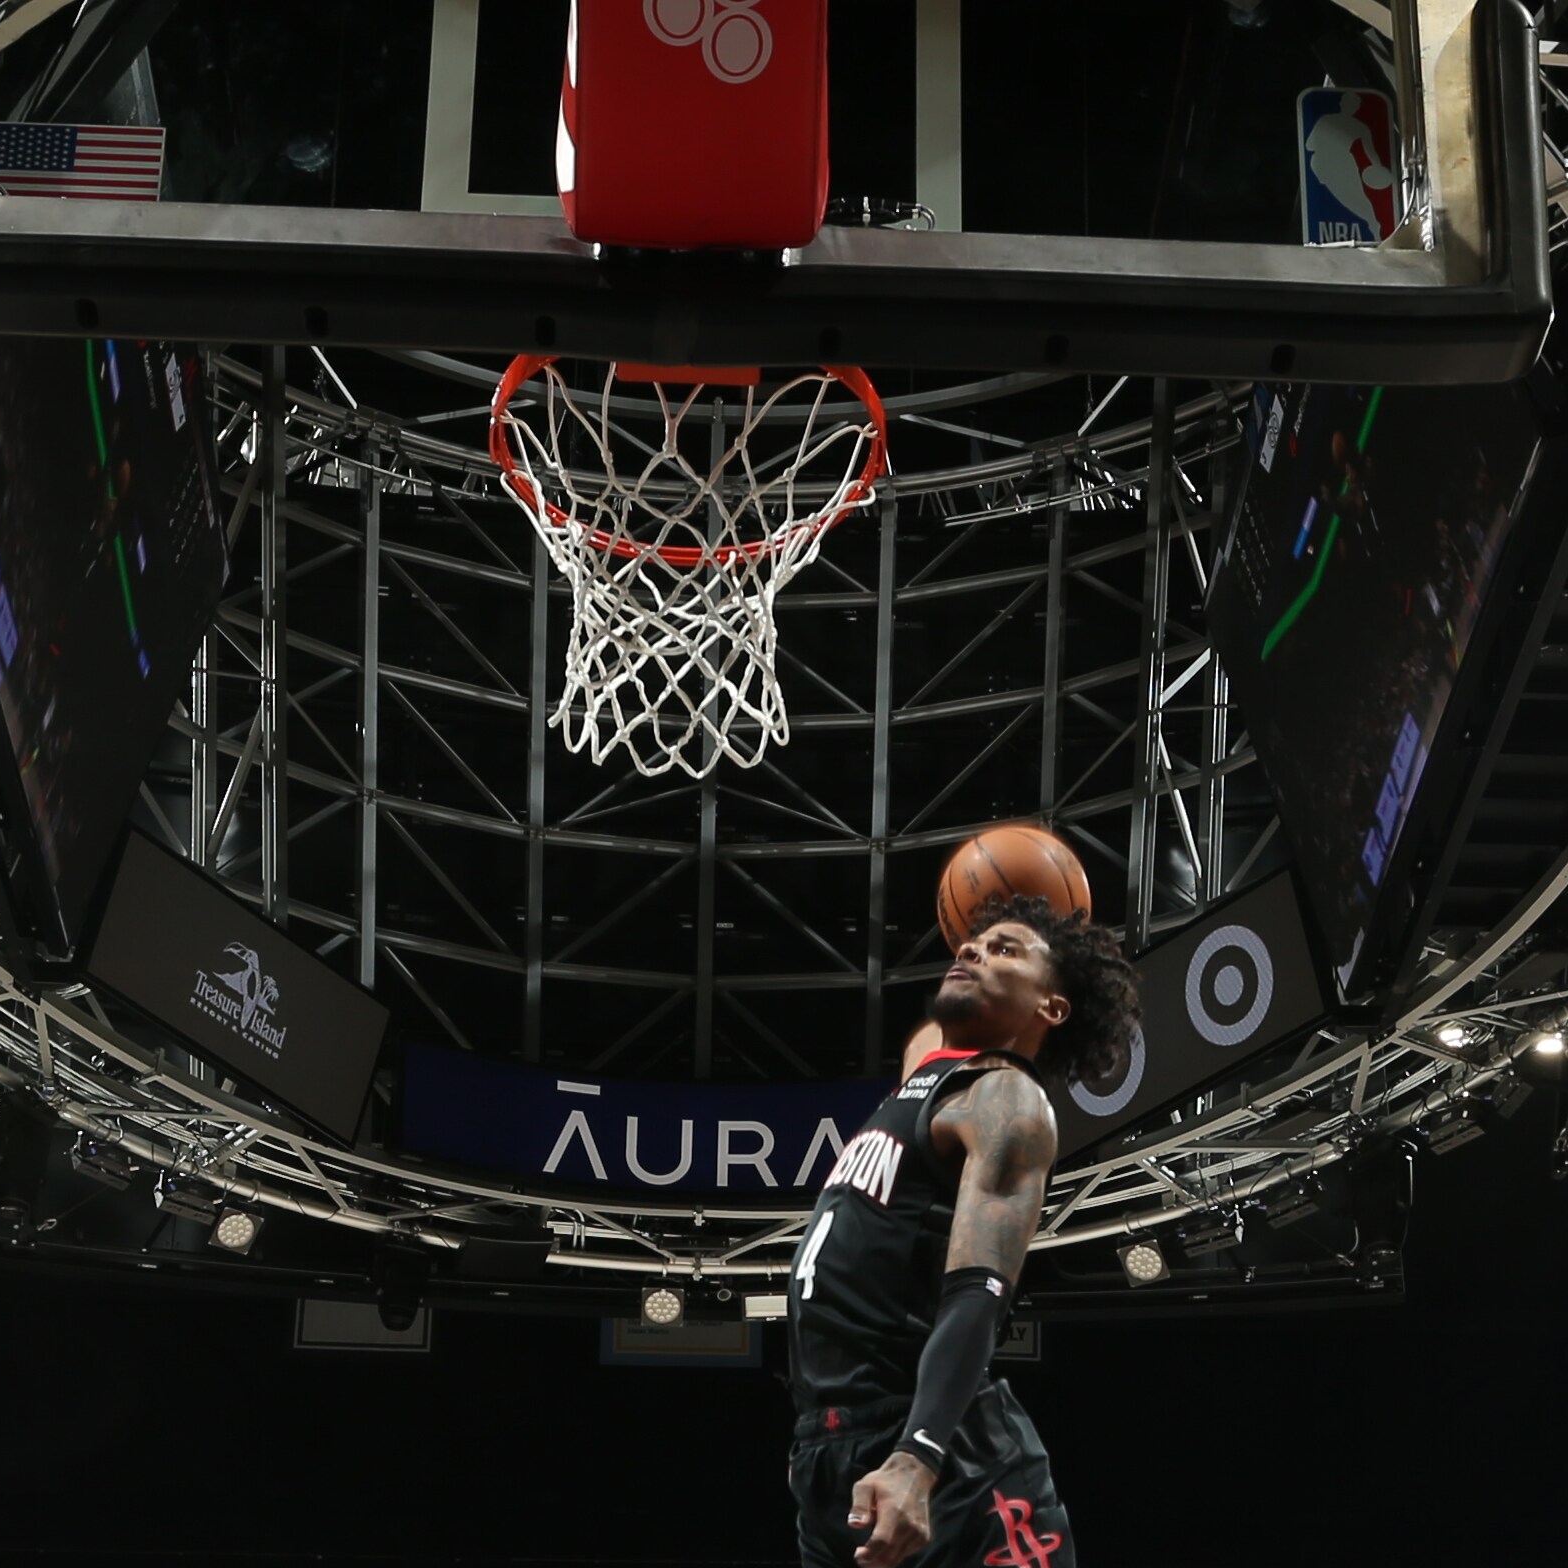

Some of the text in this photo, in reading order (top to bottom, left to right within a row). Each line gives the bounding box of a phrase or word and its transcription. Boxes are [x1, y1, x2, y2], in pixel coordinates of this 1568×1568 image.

[1317, 221, 1352, 243] NBA
[190, 996, 229, 1026] RESORT
[242, 1031, 280, 1060] CASINO
[195, 969, 288, 1050] Treasure Island
[795, 1210, 834, 1300] 4
